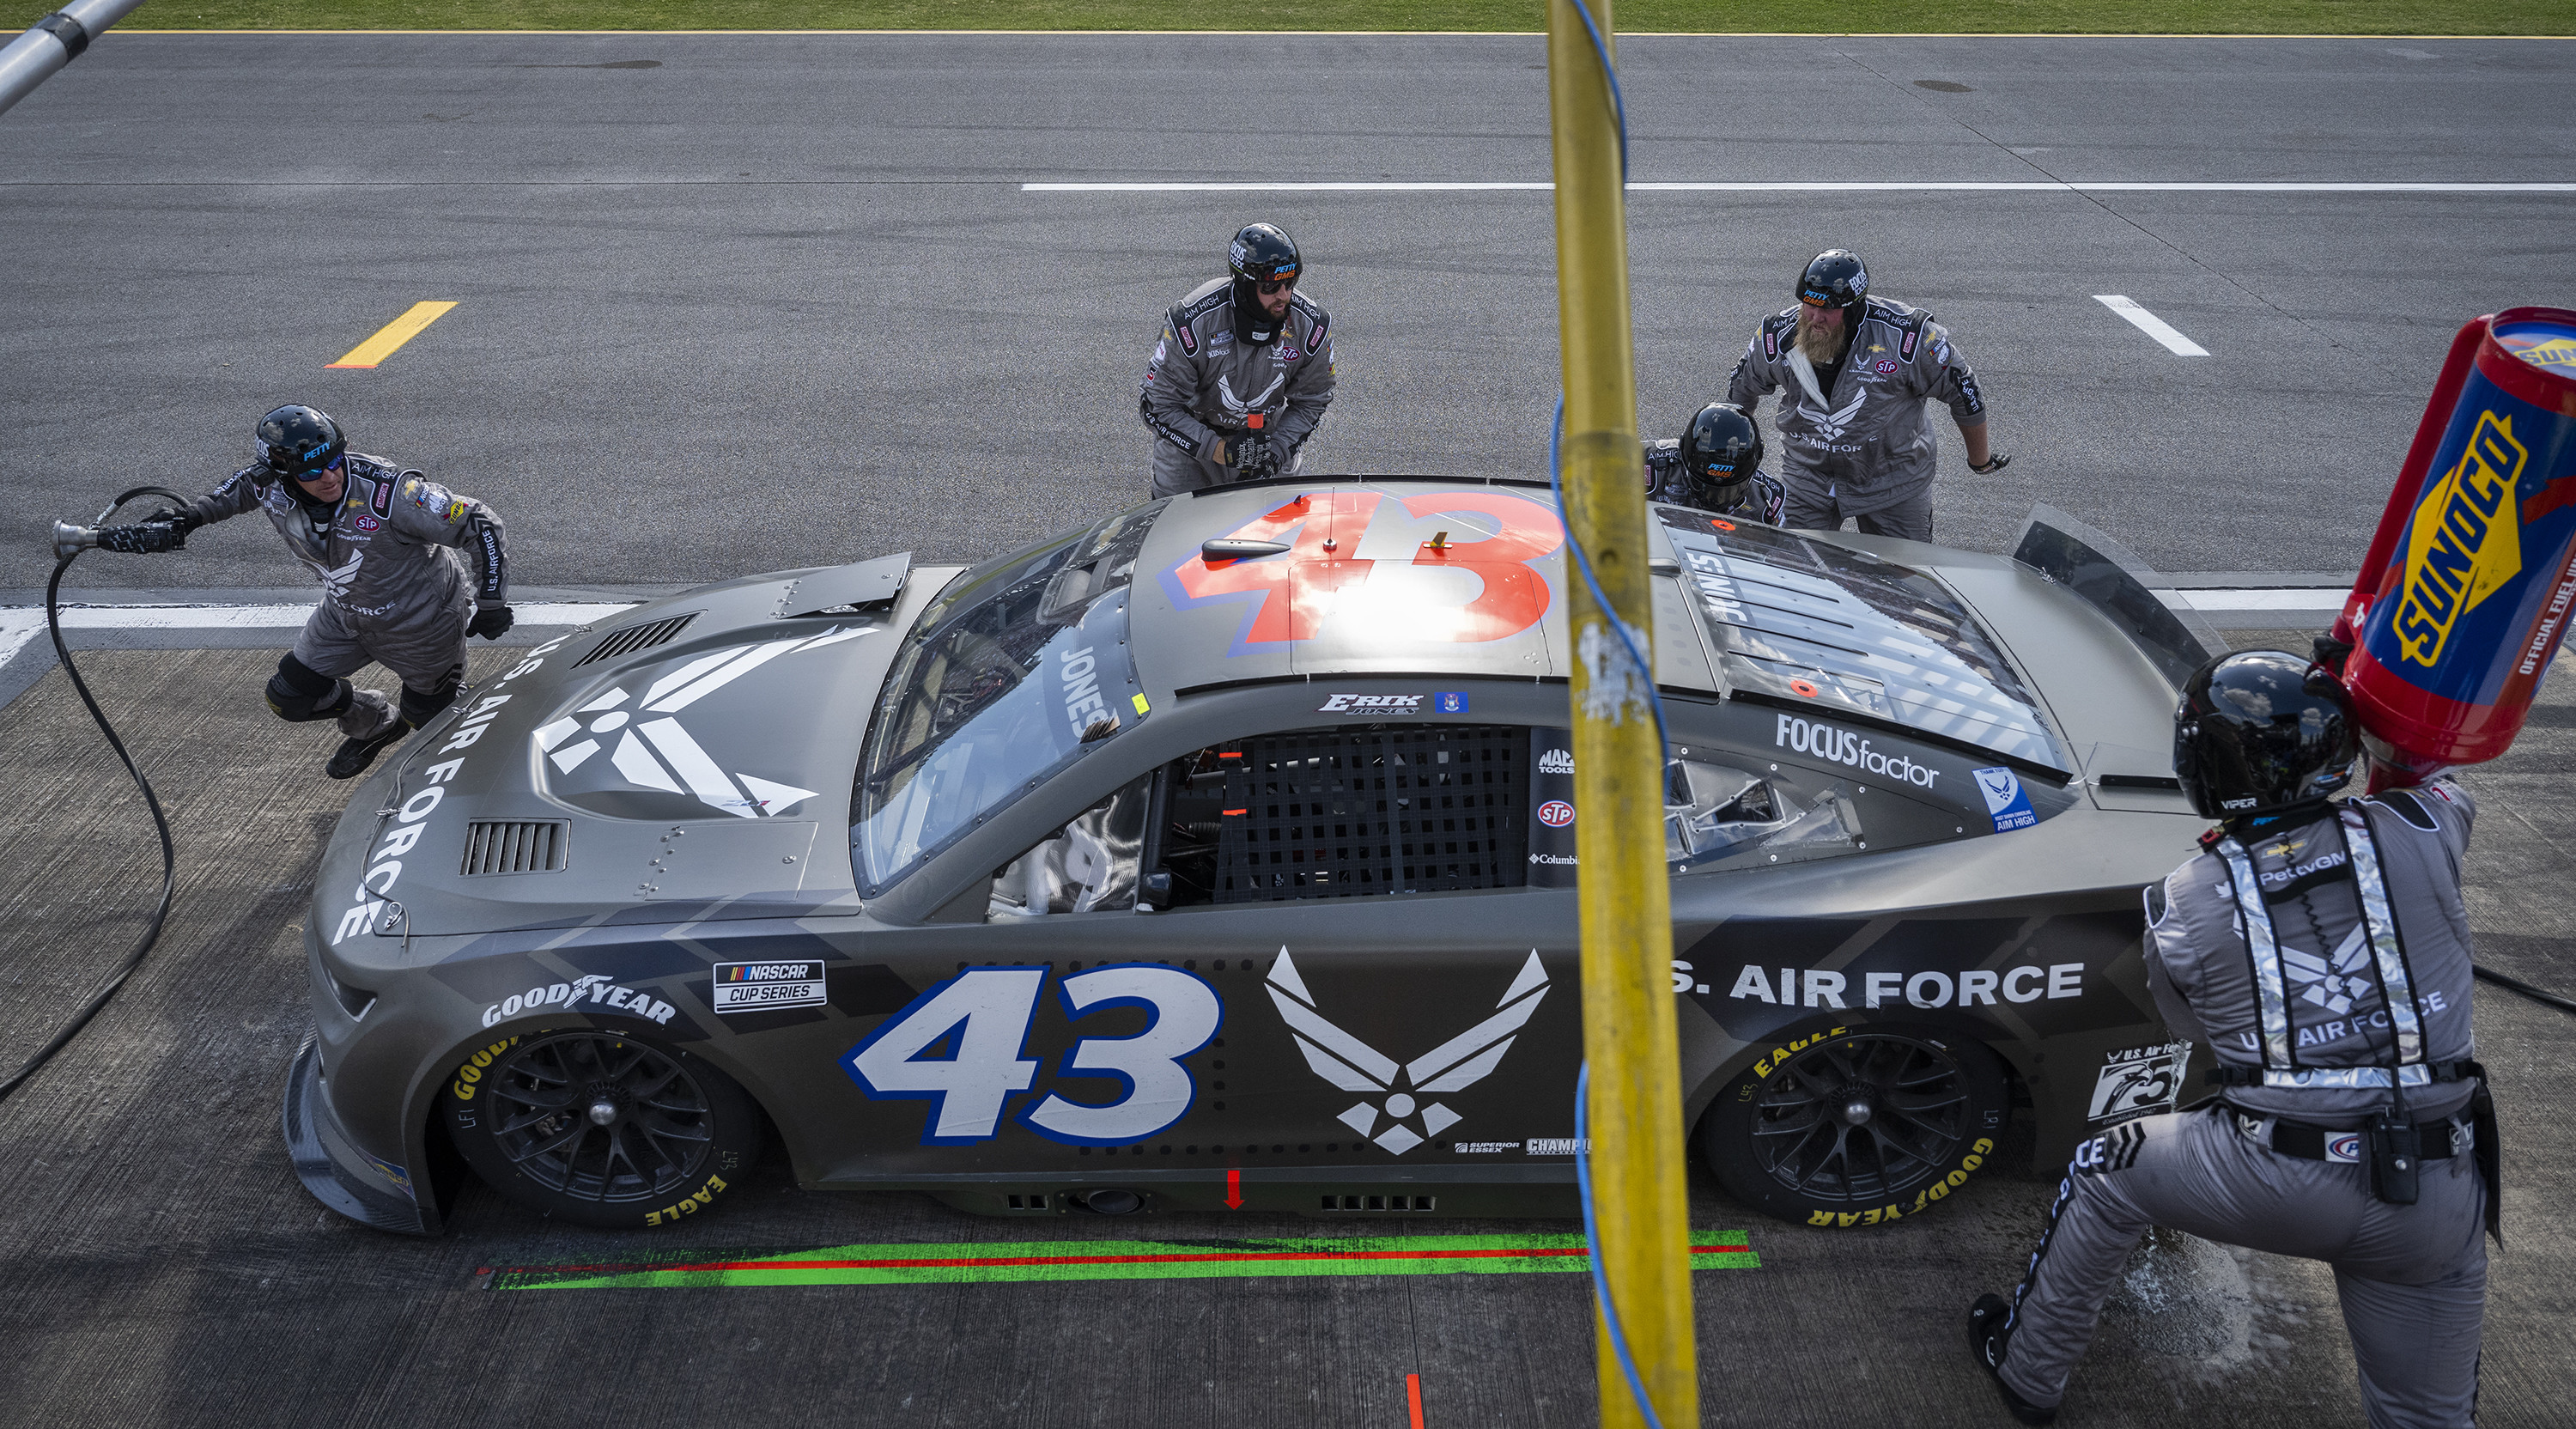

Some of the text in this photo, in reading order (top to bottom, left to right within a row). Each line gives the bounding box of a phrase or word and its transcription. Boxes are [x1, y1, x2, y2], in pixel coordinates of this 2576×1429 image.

[1274, 262, 1297, 274] PETTY
[1274, 271, 1295, 281] GMS
[1803, 295, 1826, 307] GMS
[1804, 289, 1829, 301] PETTY
[1184, 295, 1219, 320] AIM HIGH
[1303, 302, 1321, 319] HIGH
[1772, 319, 1788, 329] AIM
[1874, 308, 1912, 327] AIM HIGH
[1283, 348, 1298, 359] STP
[1878, 361, 1895, 372] STP
[303, 441, 331, 462] PETTY
[1810, 438, 1831, 452] AIR
[351, 462, 398, 480] AIM HIGH
[1706, 470, 1733, 478] GMS
[1708, 463, 1736, 472] PETTY
[358, 516, 377, 529] STP
[337, 532, 372, 542] GOODYEAR
[2398, 418, 2524, 663] SUNOCO
[1168, 491, 1567, 648] 43
[1686, 552, 1747, 623] JONES
[2518, 574, 2576, 675] OFFICIAL FUEL
[1318, 693, 1425, 713] ERIK
[1346, 706, 1419, 715] JONES
[1538, 749, 1575, 767] MAC
[1776, 713, 1941, 789] FOCUSfactor
[332, 634, 571, 946] U.S. AIR FORCE
[2221, 797, 2257, 810] VIPER
[1542, 804, 1571, 824] STP
[1997, 815, 2036, 831] AIM HIGH
[749, 964, 808, 981] NASCAR
[1671, 959, 2085, 1009] S. AIR FORCE
[729, 985, 811, 1002] CUP SERIES
[482, 977, 677, 1028] GOODYEAR
[2298, 1020, 2347, 1047] AIR
[841, 964, 1224, 1143] 43
[2123, 1049, 2142, 1061] U.S.
[2144, 1045, 2162, 1056] Air
[1807, 1137, 1994, 1227] GOODYEAR
[645, 1174, 727, 1226] EAGLE
